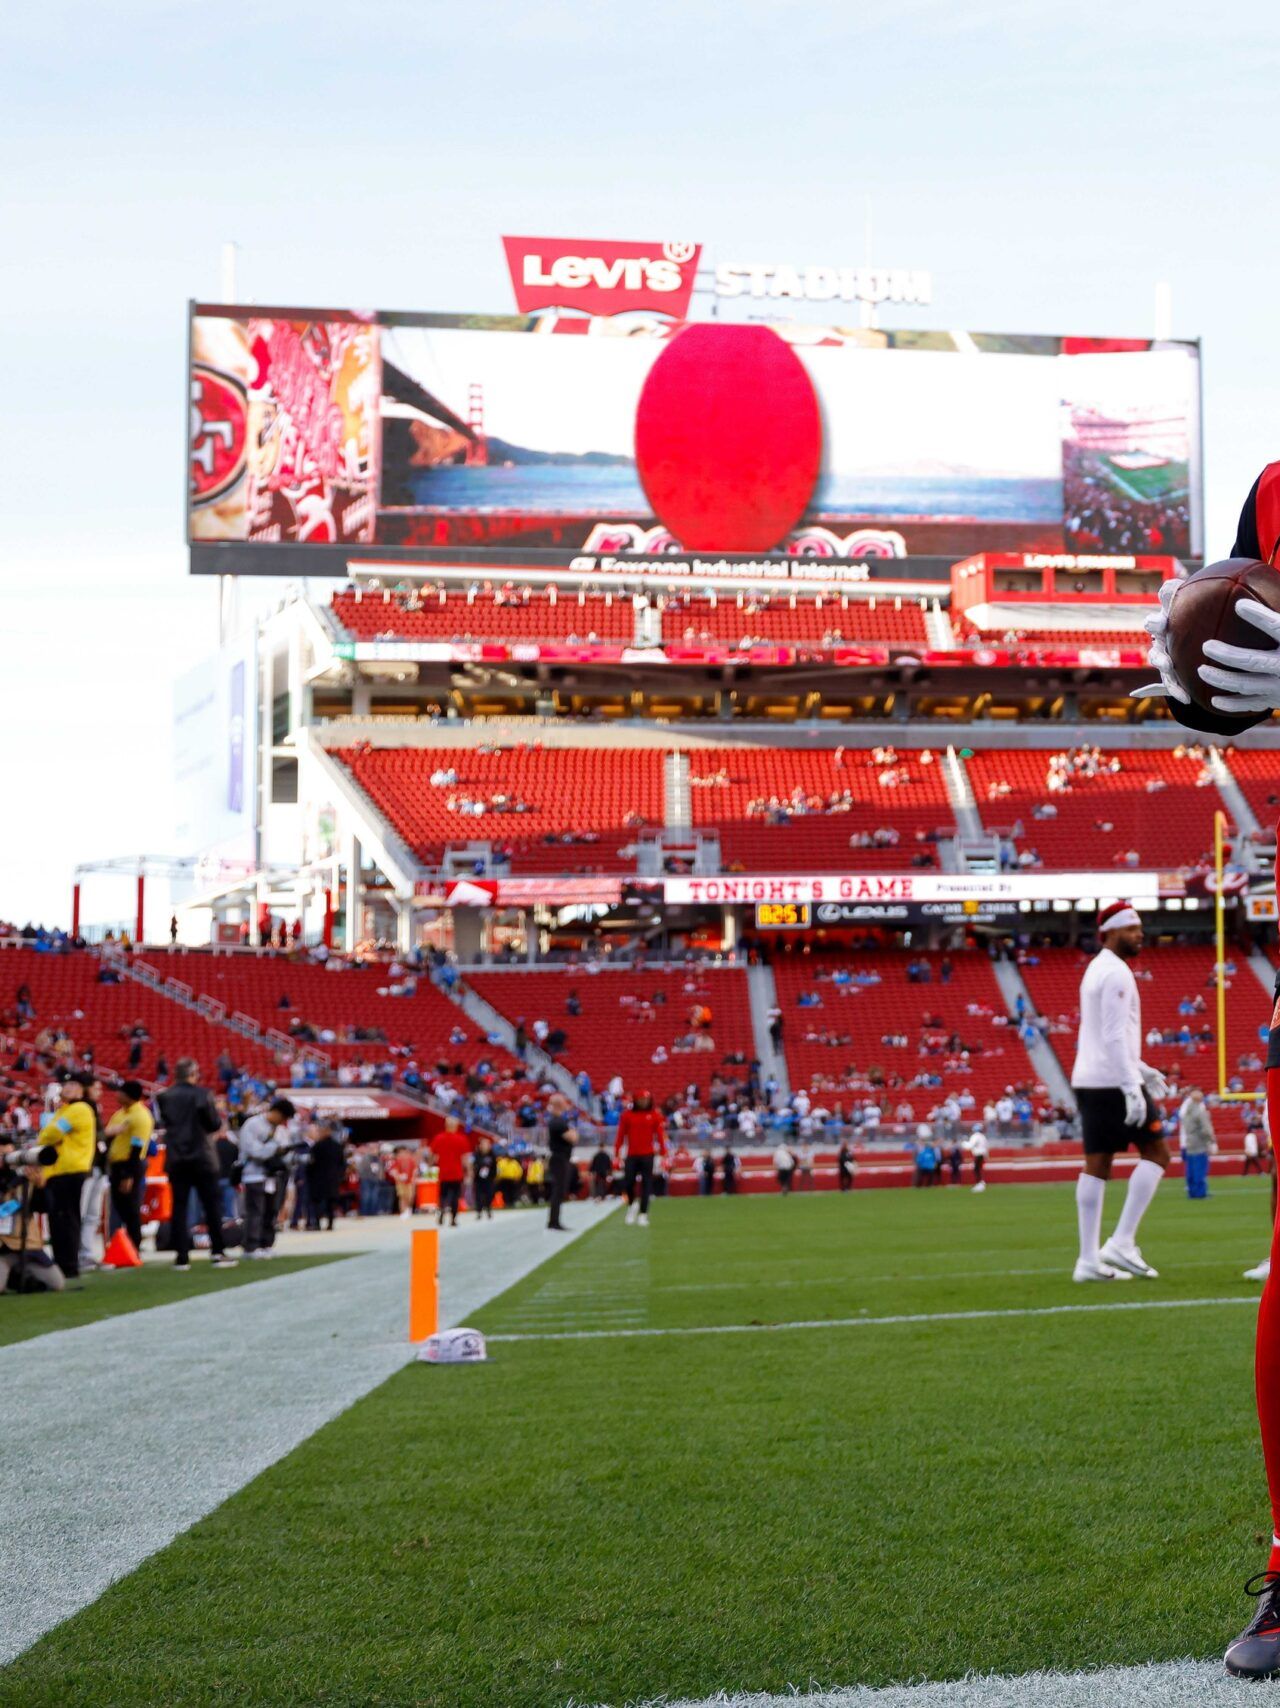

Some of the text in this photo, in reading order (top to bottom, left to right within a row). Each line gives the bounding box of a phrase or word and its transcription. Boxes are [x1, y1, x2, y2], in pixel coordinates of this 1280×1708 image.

[715, 263, 931, 303] STADIUM
[600, 556, 690, 574] Foxconn
[693, 559, 789, 577] Industrial
[791, 561, 870, 580] Internet
[689, 881, 824, 899] TONIGHT'S
[839, 878, 914, 898] GAME
[936, 883, 992, 892] Presented
[842, 906, 909, 918] LEXUS
